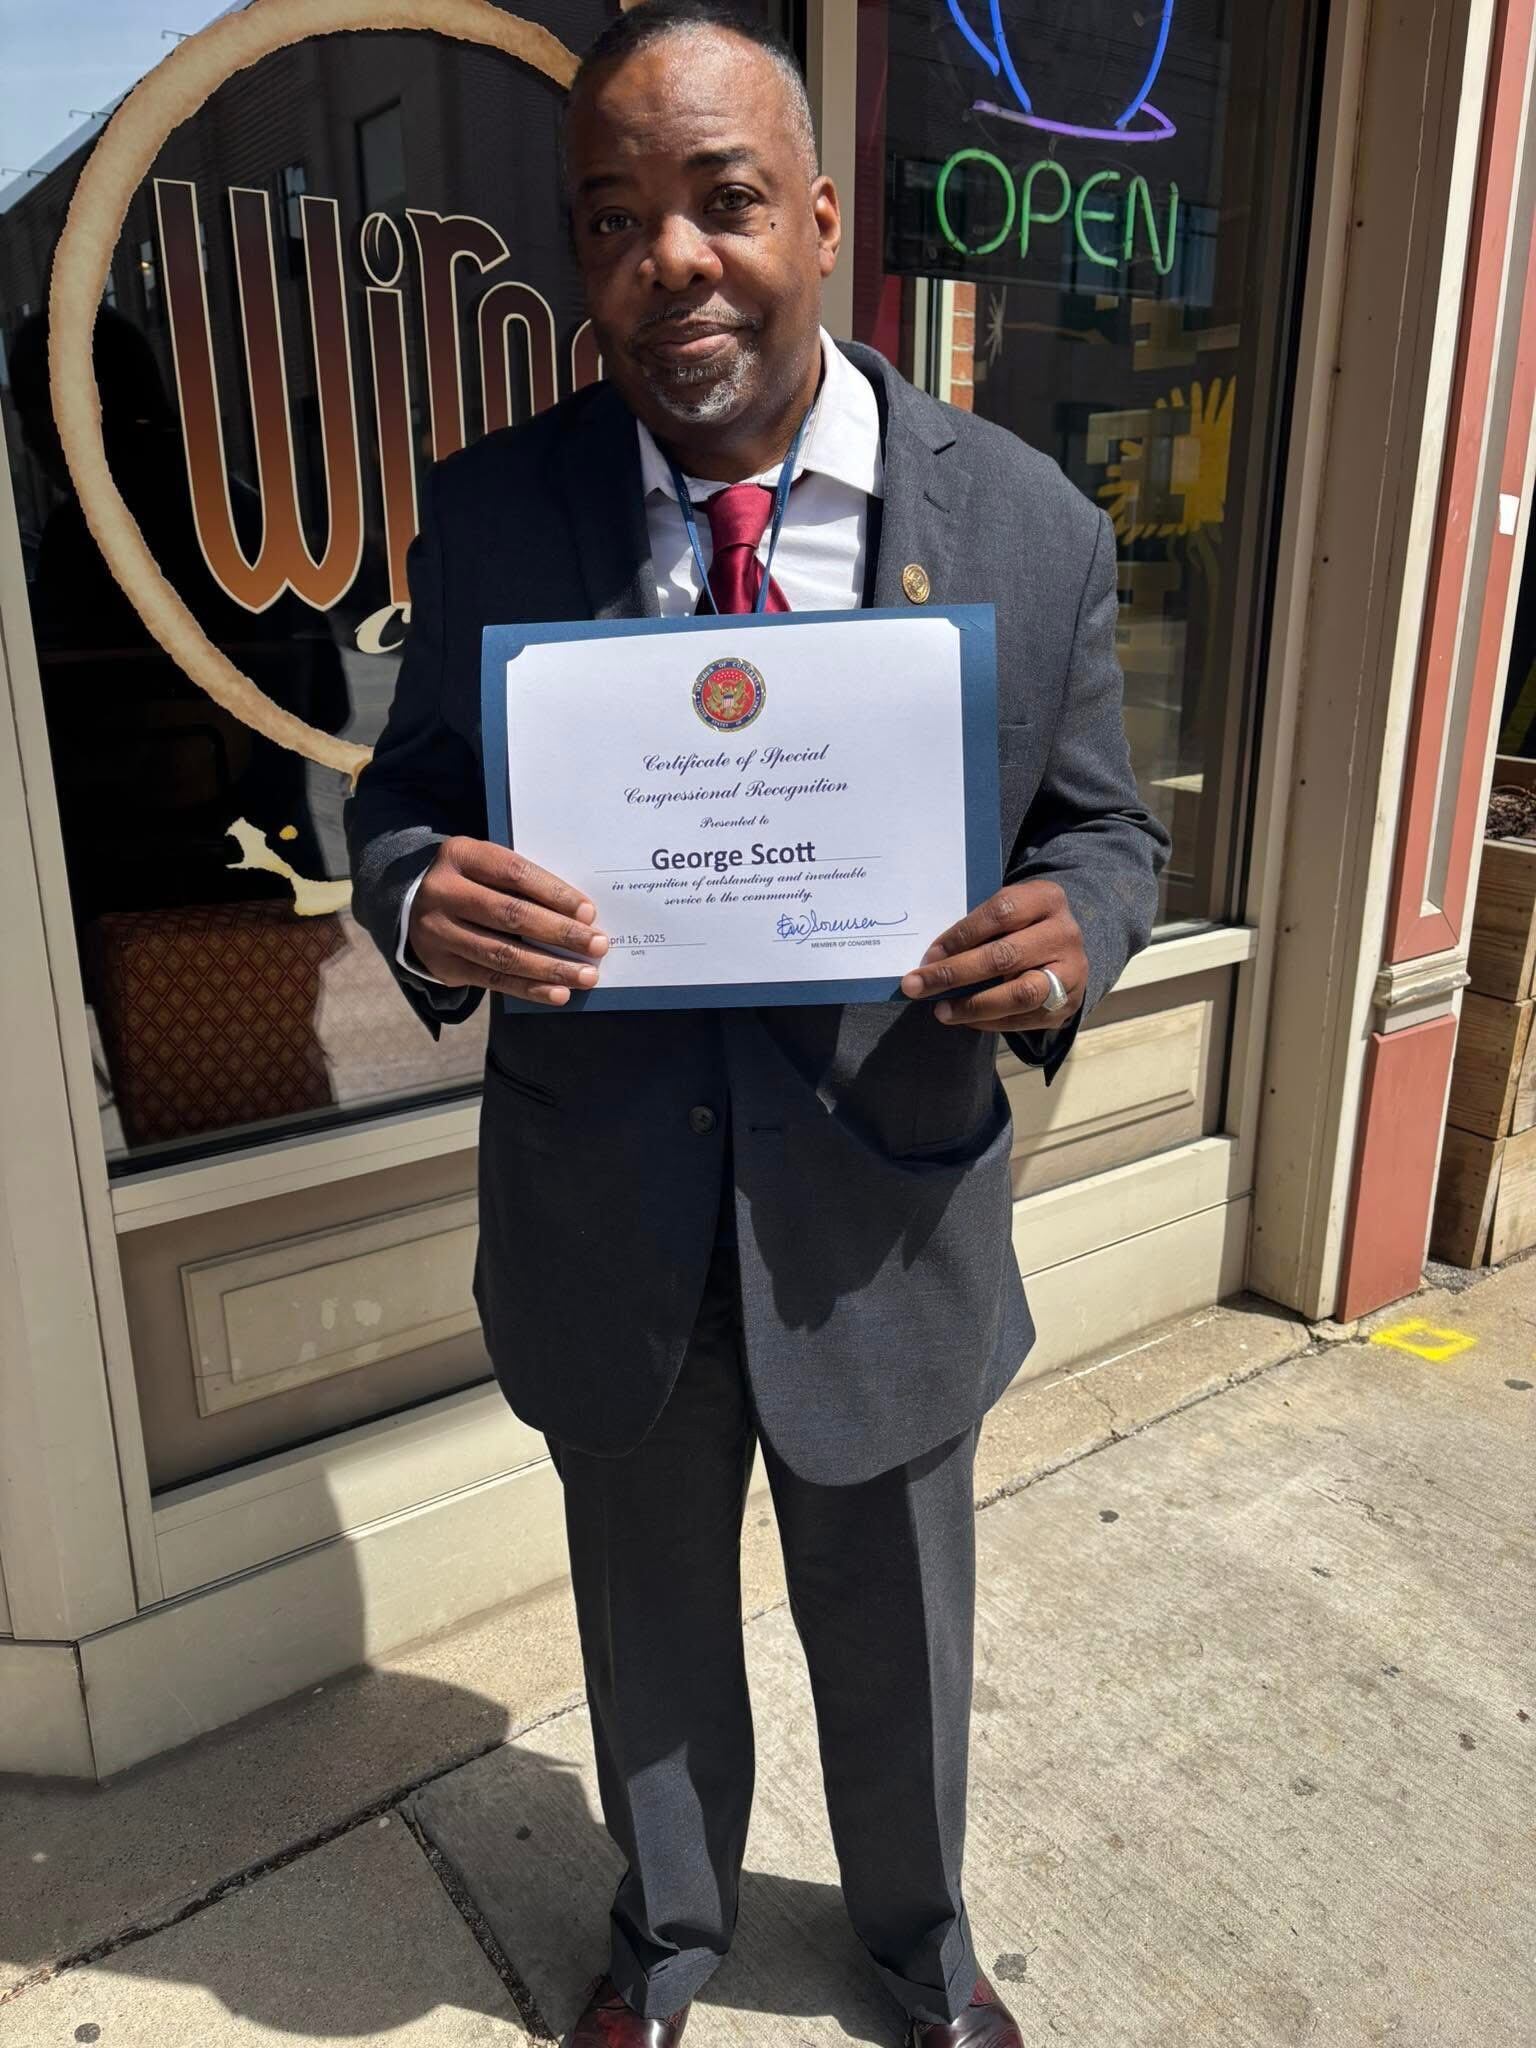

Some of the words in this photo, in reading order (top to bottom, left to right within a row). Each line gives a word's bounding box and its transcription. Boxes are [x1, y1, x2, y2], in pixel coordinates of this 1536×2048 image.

[936, 149, 1179, 275] OPEN
[643, 752, 730, 776] Certificate
[736, 748, 757, 772] of
[760, 744, 830, 769] Special
[624, 782, 741, 809] Congressional
[745, 778, 848, 801] Recognition
[700, 816, 757, 828] Presented
[759, 814, 769, 825] to
[651, 848, 743, 872] George
[751, 841, 816, 865] Scott
[612, 881, 624, 890] in
[629, 878, 688, 893] recognition
[692, 876, 706, 891] of
[706, 873, 774, 887] outstanding
[777, 872, 803, 882] and
[805, 866, 866, 881] invaluable
[664, 895, 703, 905] service
[706, 893, 716, 903] to
[720, 891, 739, 902] the
[742, 888, 813, 903] community.
[608, 935, 625, 945] pril
[628, 935, 641, 945] 16,
[643, 934, 666, 943] 2025
